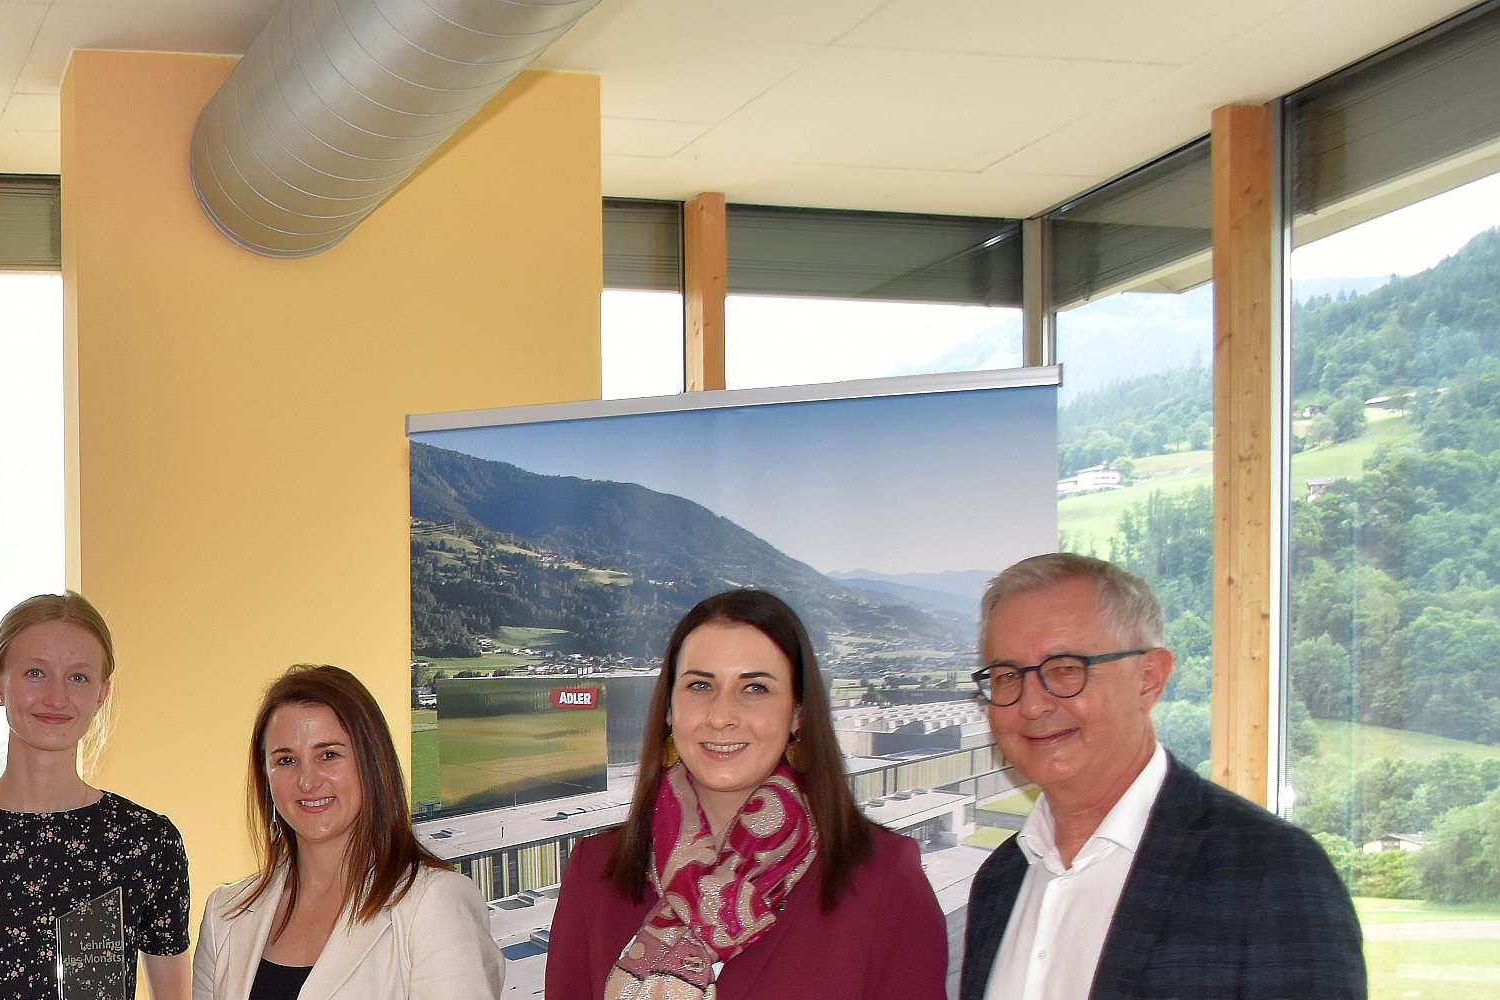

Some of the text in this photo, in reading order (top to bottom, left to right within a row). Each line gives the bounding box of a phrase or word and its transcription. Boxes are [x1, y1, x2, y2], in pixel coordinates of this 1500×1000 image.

[559, 691, 592, 705] ADLER
[80, 939, 122, 952] Lehrling
[84, 953, 122, 964] Monats
